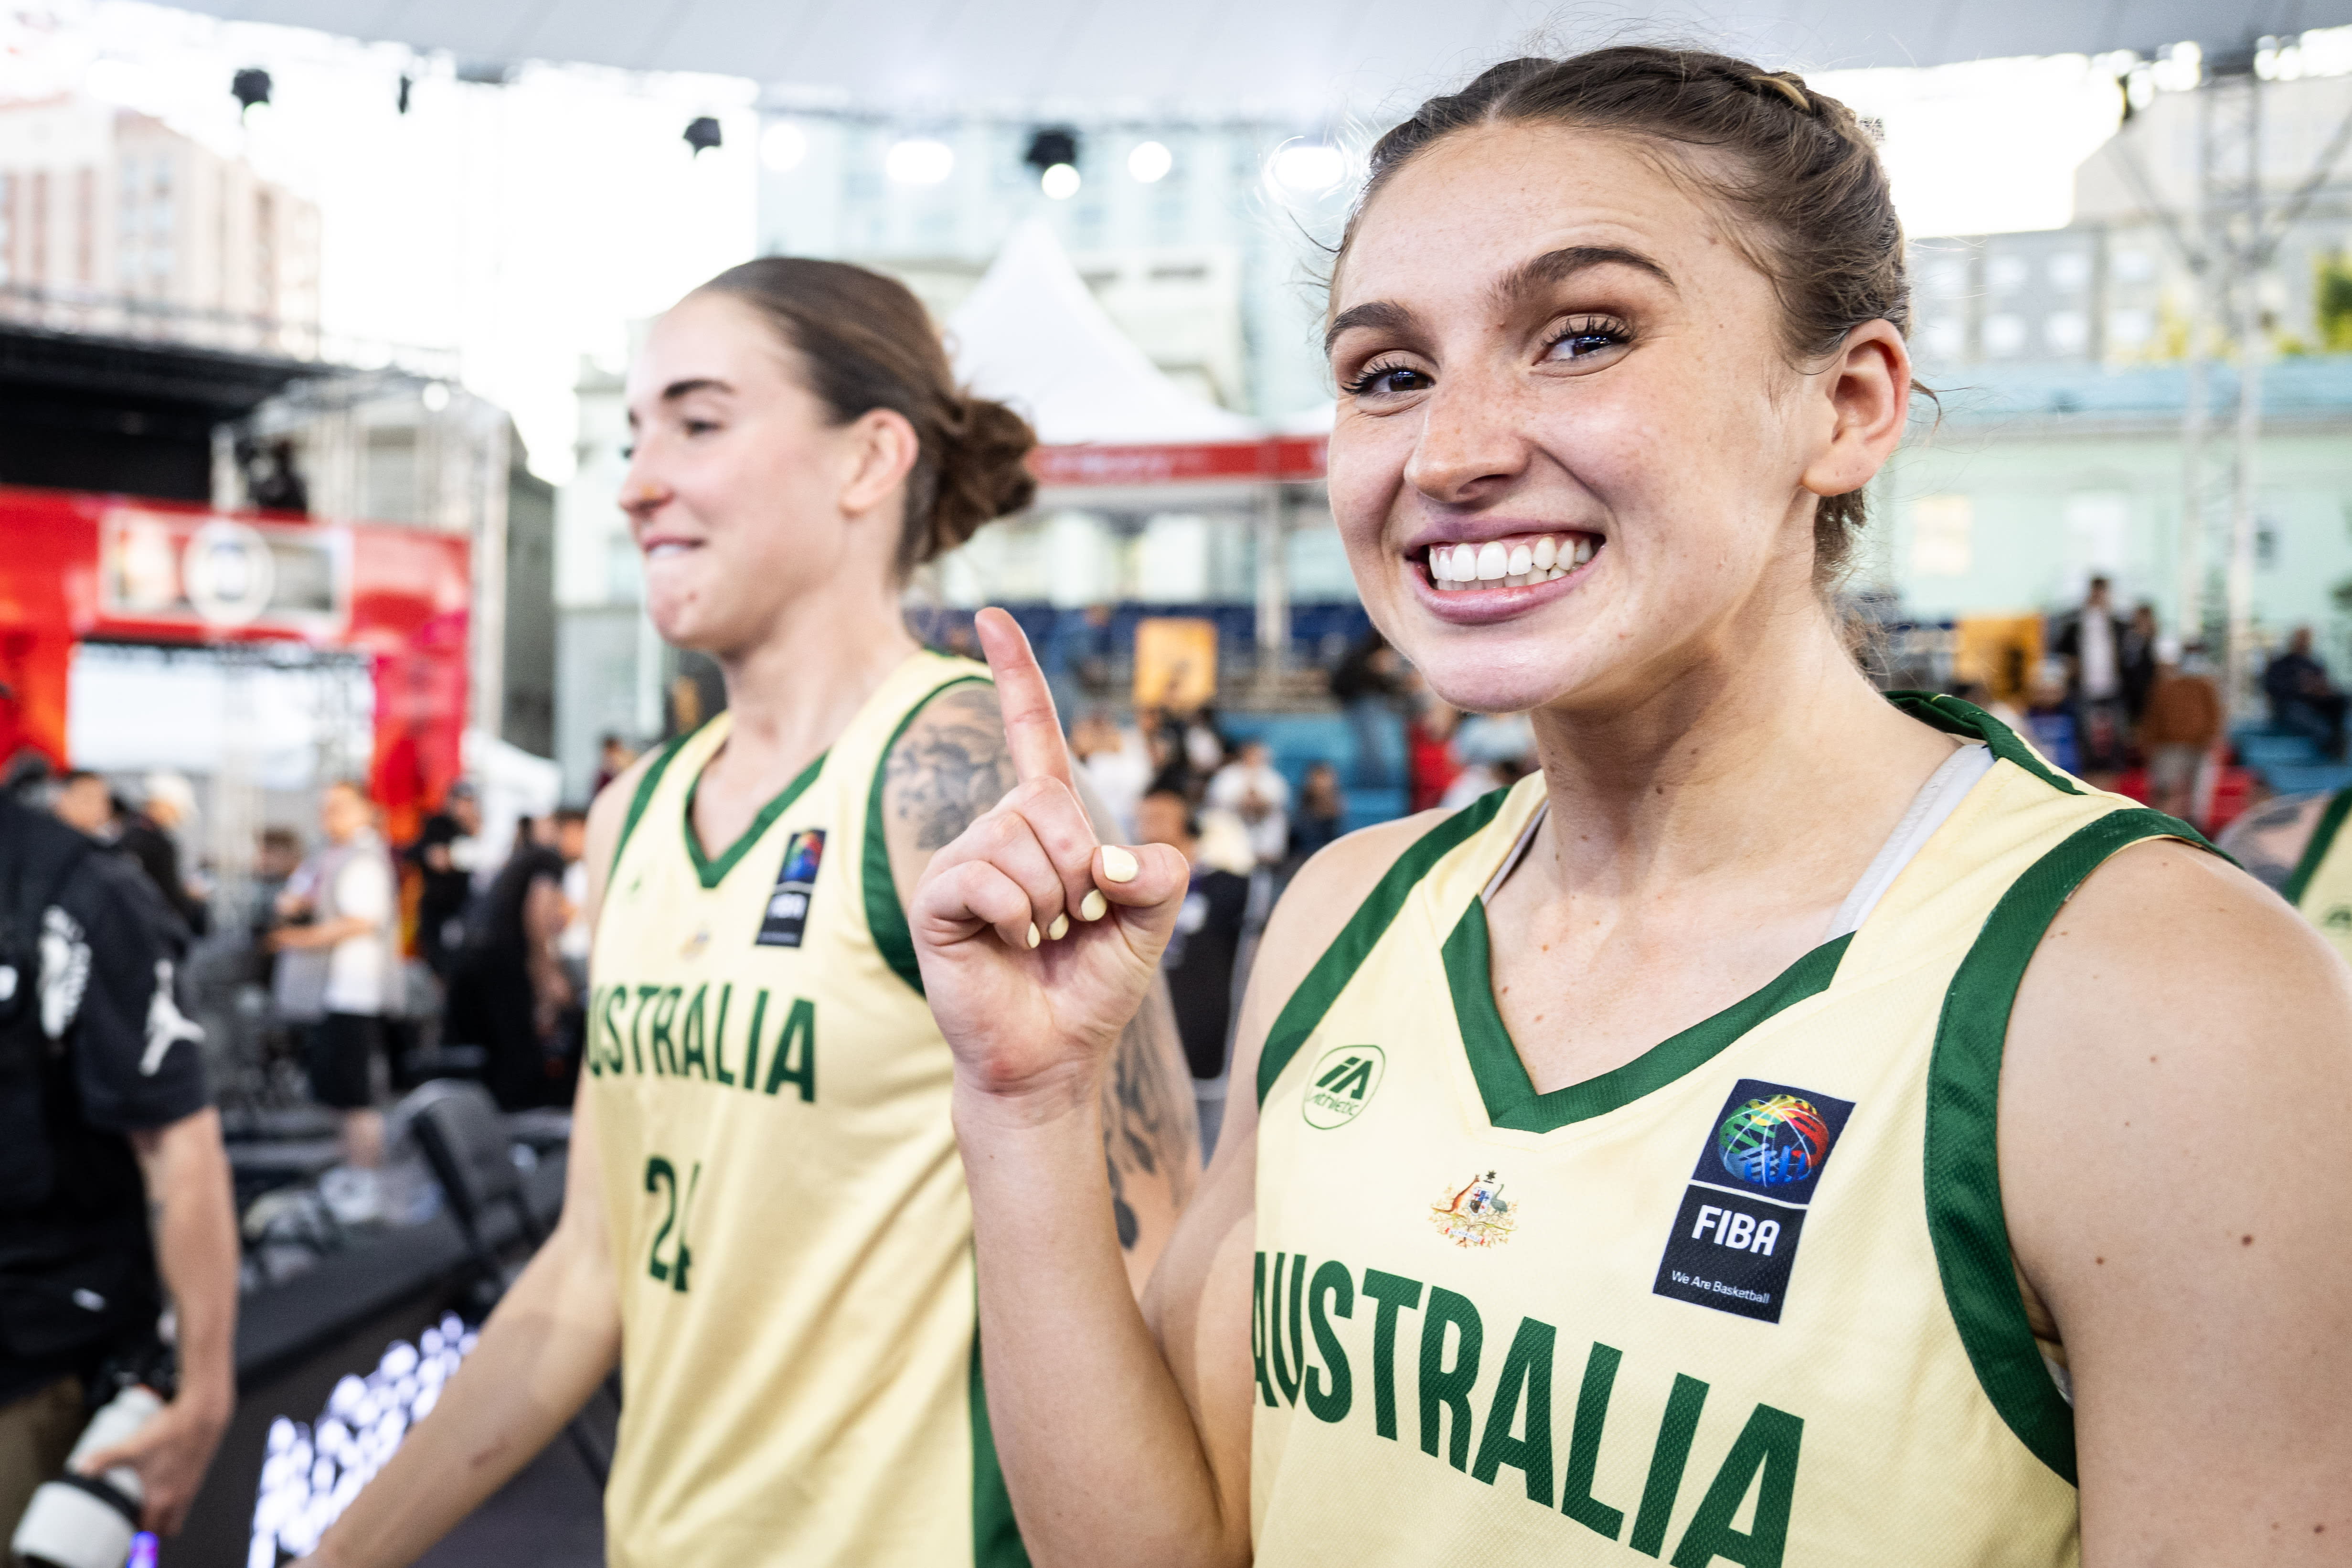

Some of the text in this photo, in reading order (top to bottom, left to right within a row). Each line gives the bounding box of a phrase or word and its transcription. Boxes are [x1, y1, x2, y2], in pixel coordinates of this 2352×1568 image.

[1691, 1204, 1781, 1257] FIBA
[1672, 1269, 1771, 1304] We Are Basketball
[1252, 1251, 1805, 1568] AUSTRALIA
